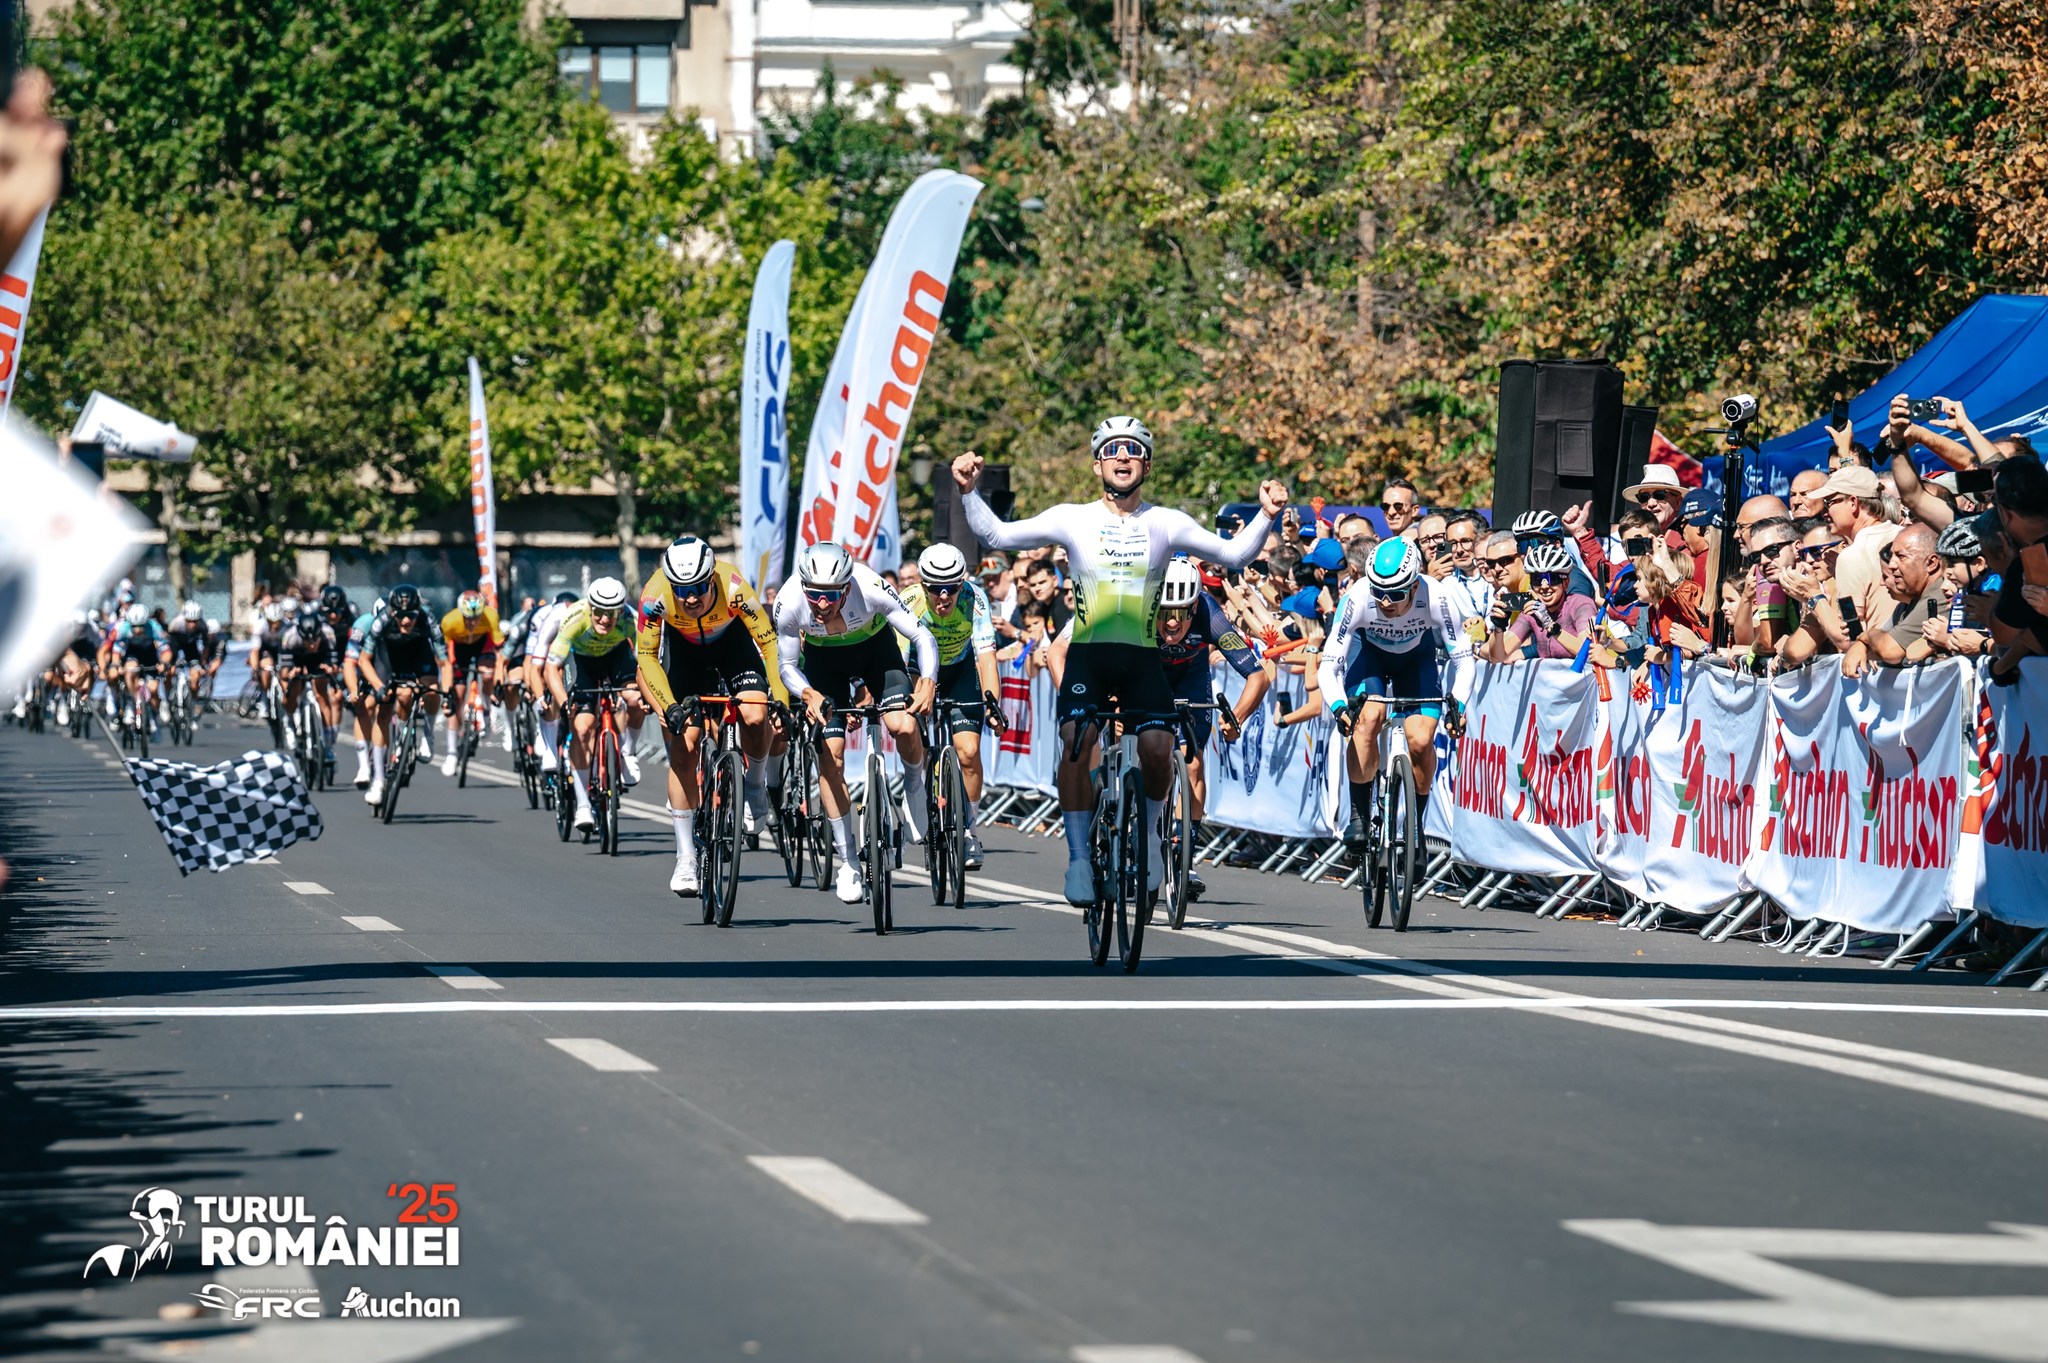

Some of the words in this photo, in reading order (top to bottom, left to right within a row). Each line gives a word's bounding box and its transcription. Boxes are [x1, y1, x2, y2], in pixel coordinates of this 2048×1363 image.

[740, 603, 759, 622] Balm
[881, 579, 910, 614] VOSTER
[1439, 596, 1457, 641] MERIDA
[1336, 598, 1356, 645] MERIDA
[1367, 626, 1427, 637] BAHRAIN
[726, 724, 734, 751] BMC
[1512, 703, 1593, 829] Auchan
[1760, 717, 1850, 860] Auchan
[1860, 722, 1957, 870] Auchan
